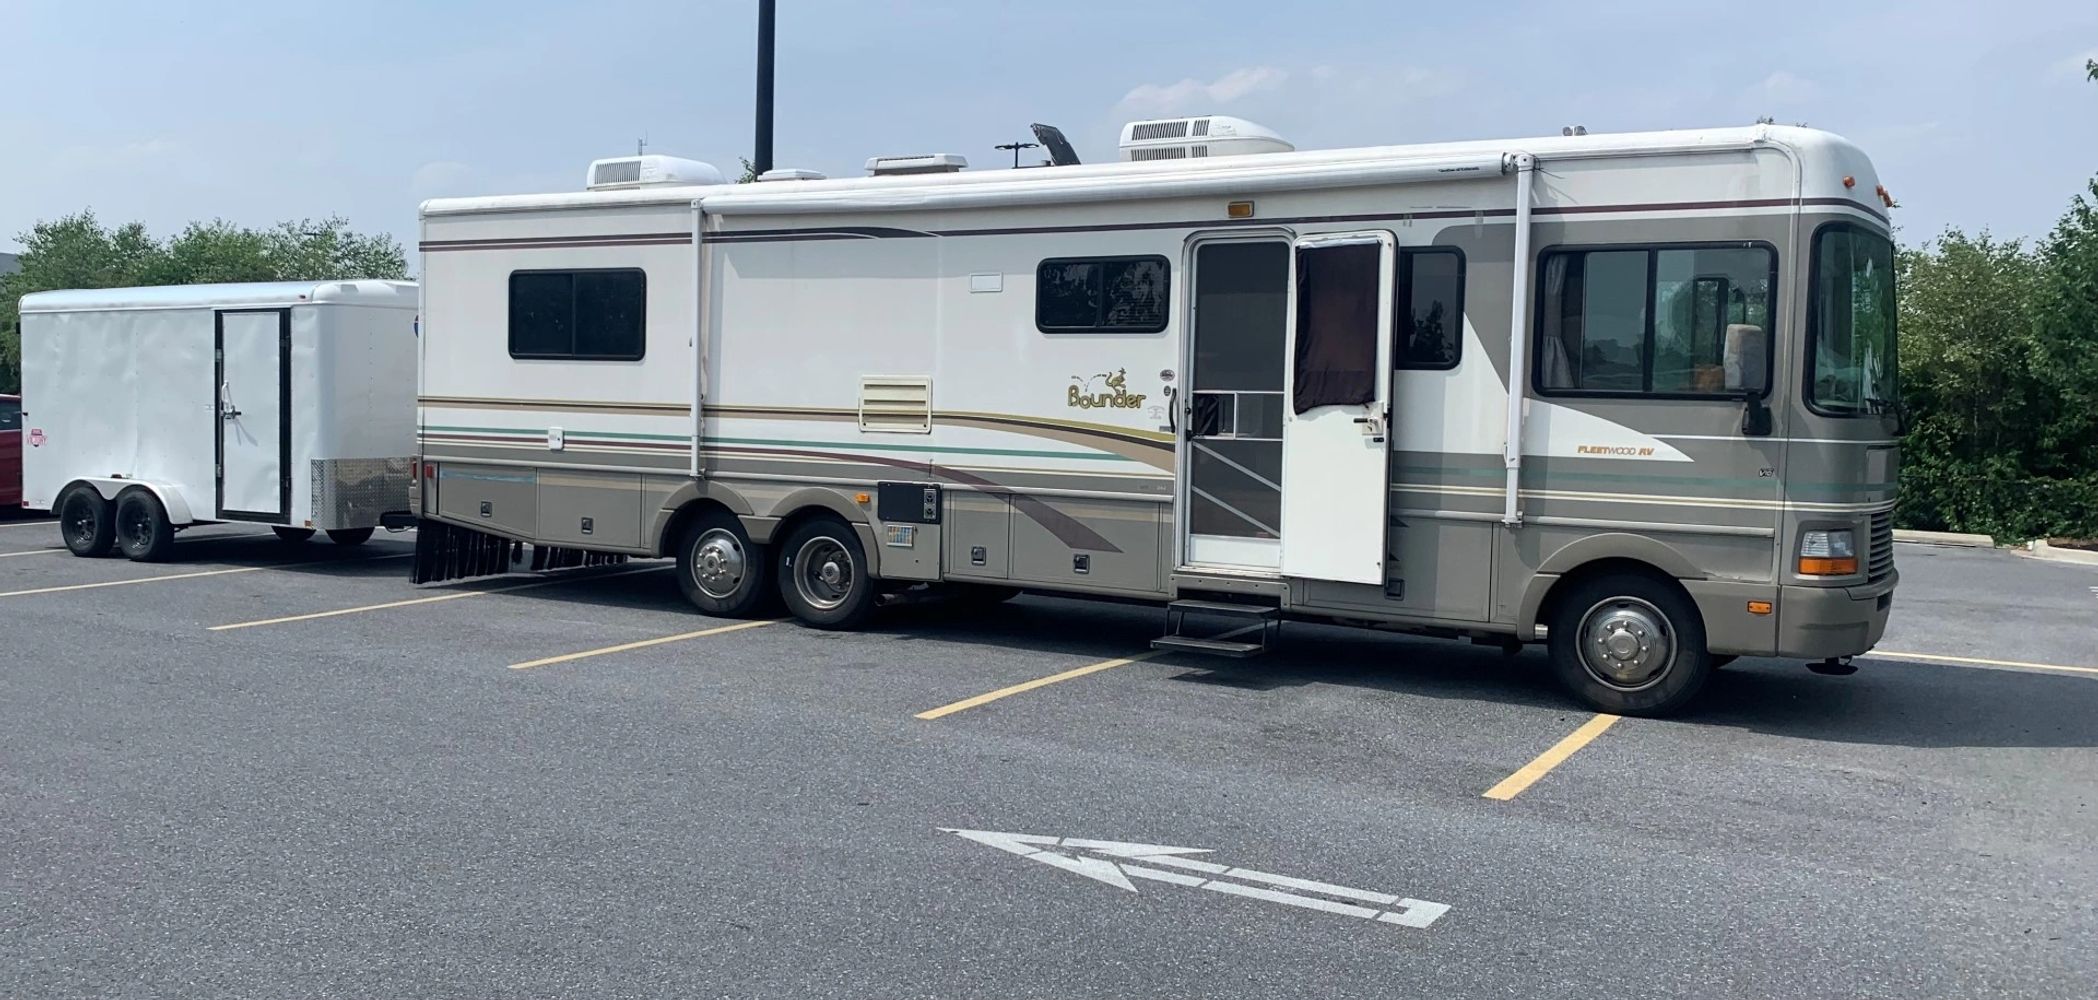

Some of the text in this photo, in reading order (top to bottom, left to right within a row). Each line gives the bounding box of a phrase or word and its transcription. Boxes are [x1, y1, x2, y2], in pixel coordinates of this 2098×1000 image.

[1068, 385, 1147, 409] Bounder
[1577, 445, 1655, 456] FLEETWOOD RV
